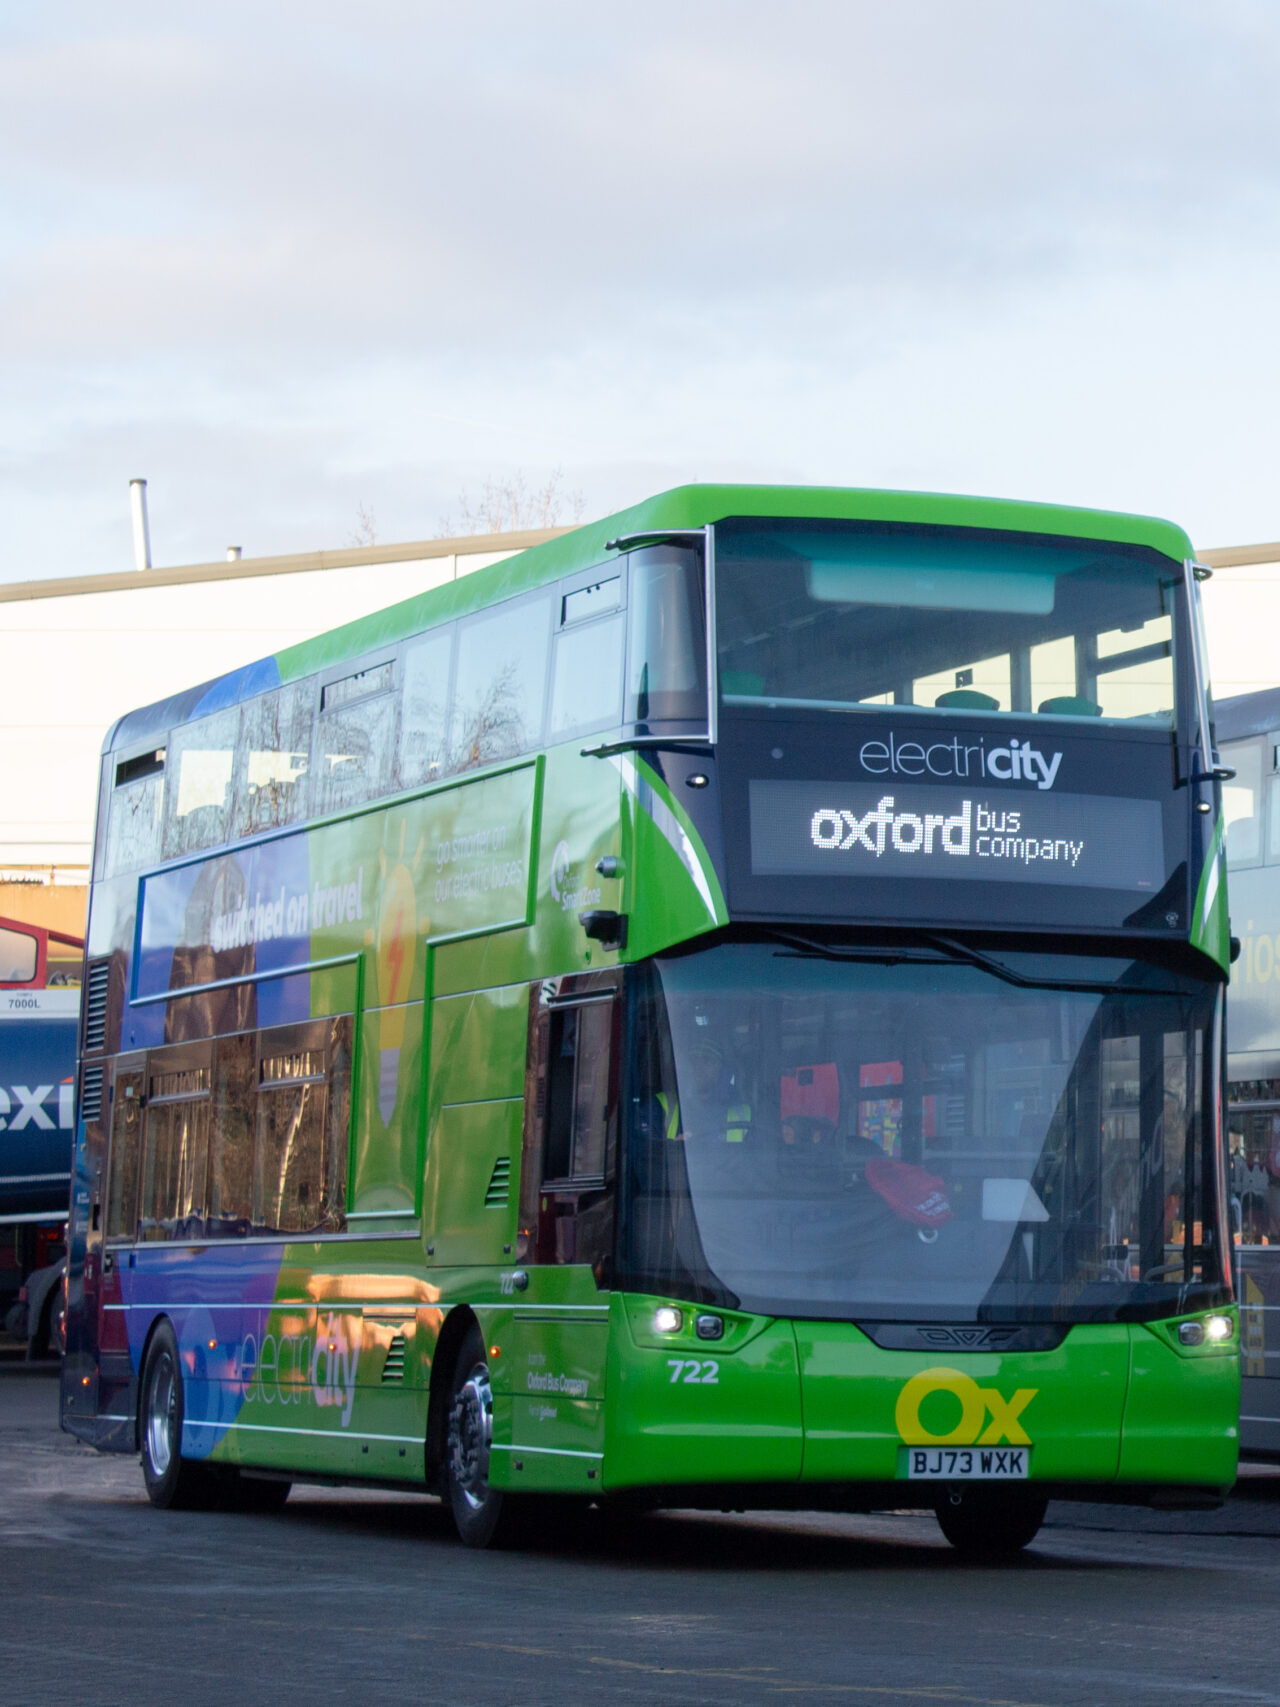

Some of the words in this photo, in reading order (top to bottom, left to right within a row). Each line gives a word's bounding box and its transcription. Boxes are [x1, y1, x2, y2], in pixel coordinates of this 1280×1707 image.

[860, 732, 1063, 789] electricity
[811, 796, 972, 857] oxford
[976, 804, 1020, 832] bus
[976, 836, 1083, 867] company
[211, 886, 286, 953] switched
[286, 893, 309, 935] on
[312, 866, 363, 930] travel
[241, 1310, 361, 1427] electricity
[668, 1360, 719, 1384] 722
[895, 1367, 1039, 1446] Ox
[914, 1452, 973, 1474] BJ73
[980, 1452, 1023, 1474] WXK
